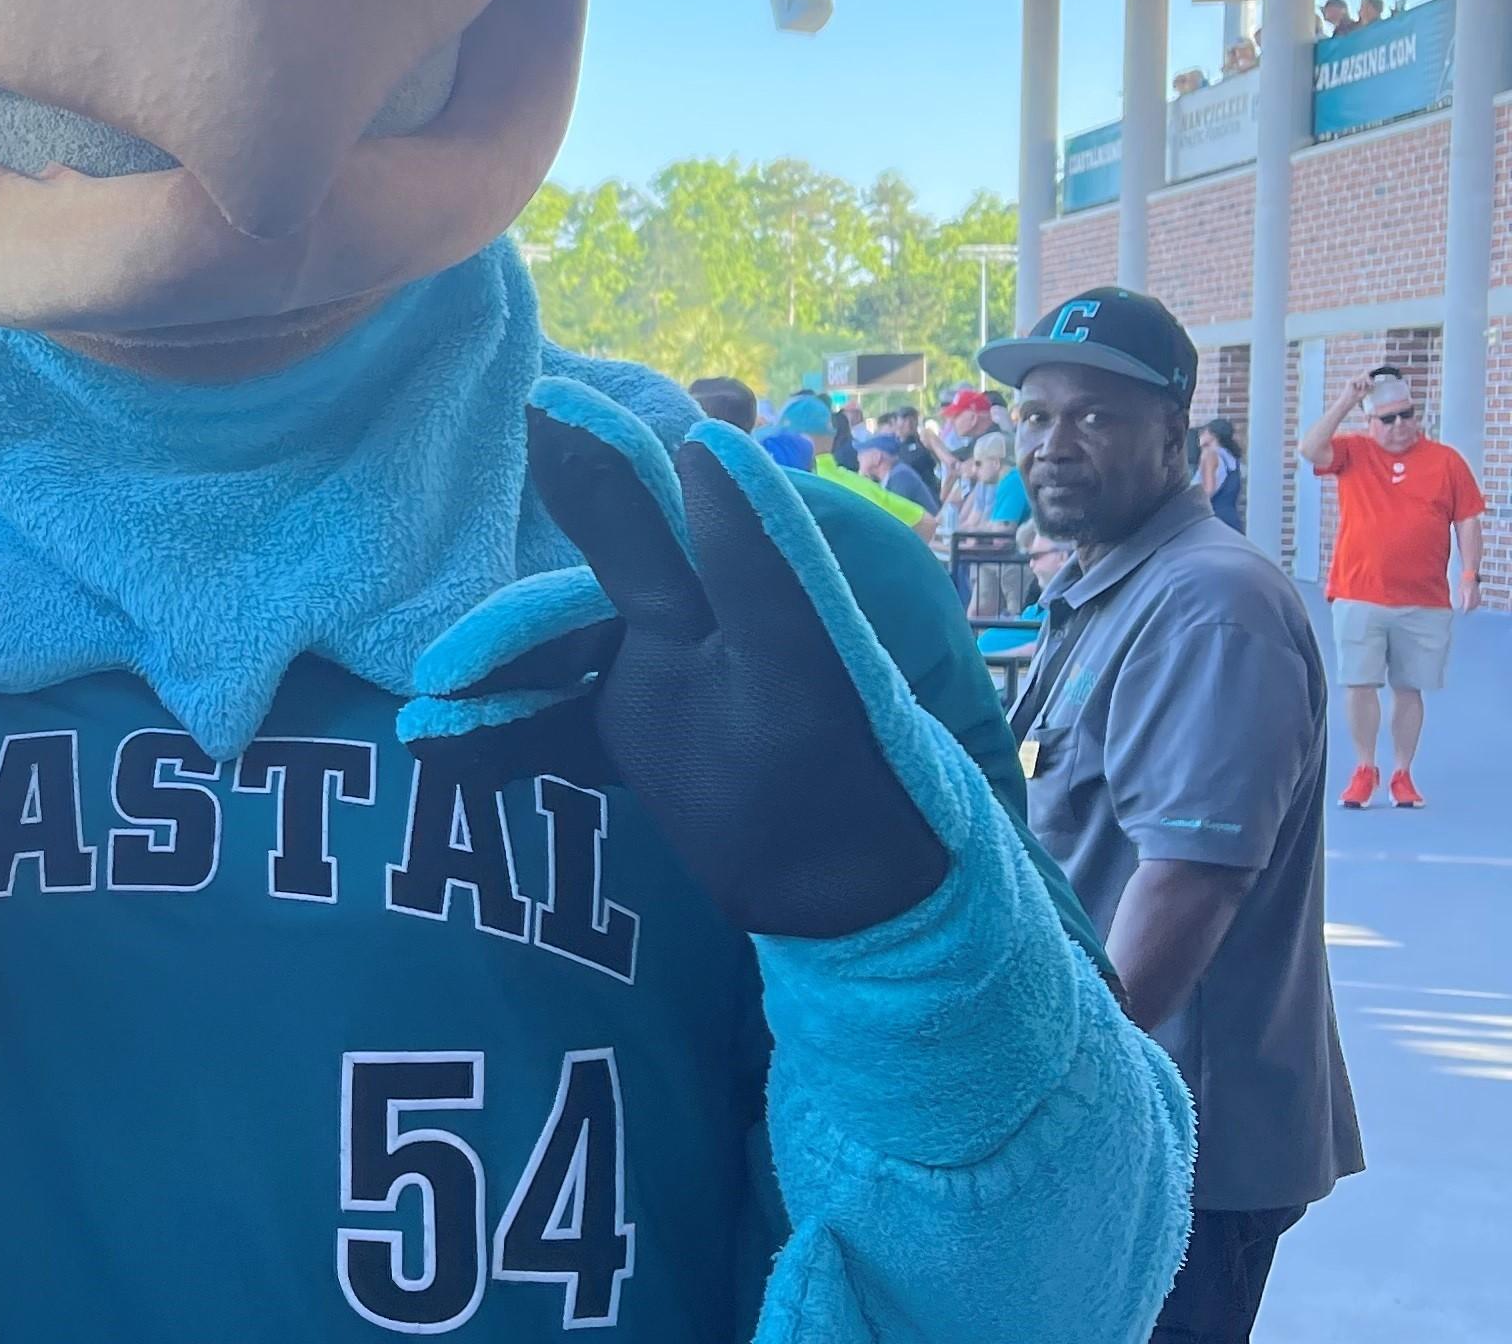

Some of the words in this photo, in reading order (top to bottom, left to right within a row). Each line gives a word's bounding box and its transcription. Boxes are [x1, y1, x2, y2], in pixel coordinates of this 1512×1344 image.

[1315, 33, 1417, 91] ALRISING.COM
[1050, 301, 1101, 342] C
[338, 1046, 636, 1336] 54
